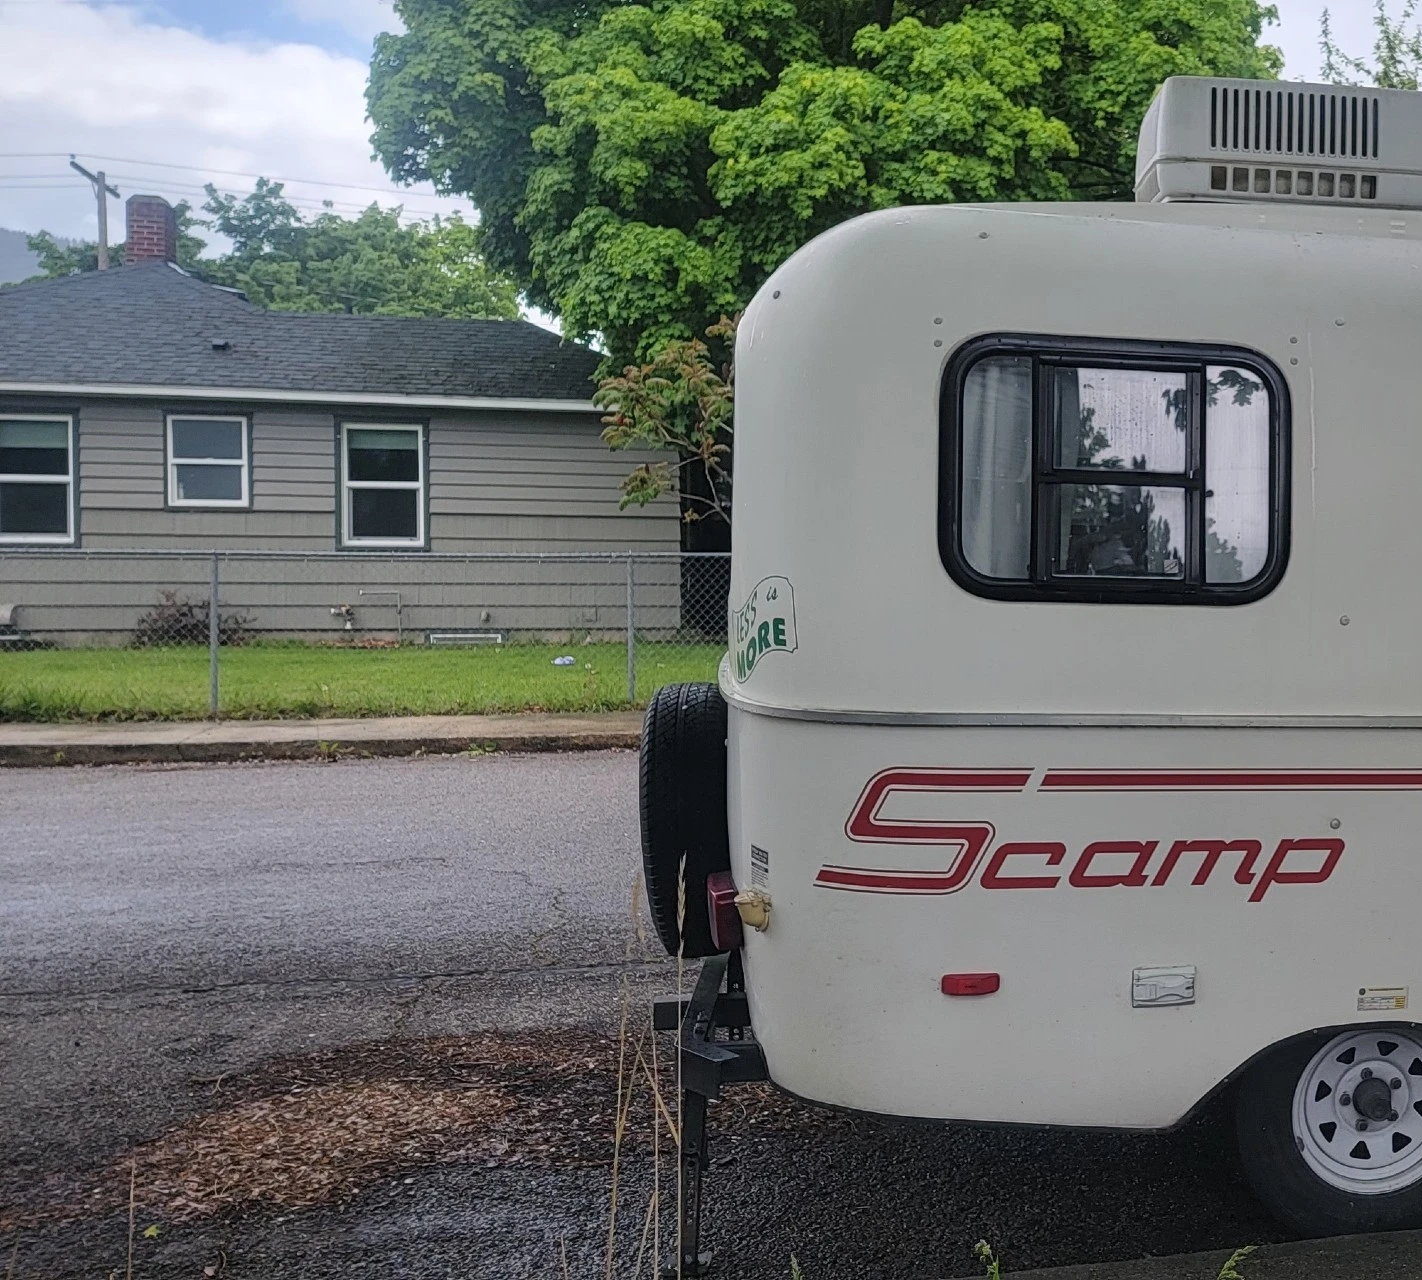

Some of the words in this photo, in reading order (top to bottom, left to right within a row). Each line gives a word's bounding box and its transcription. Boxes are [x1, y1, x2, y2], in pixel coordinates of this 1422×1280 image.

[736, 590, 758, 645] LESS
[766, 586, 778, 601] is
[736, 617, 787, 680] MORE
[813, 766, 1346, 903] Scamp
